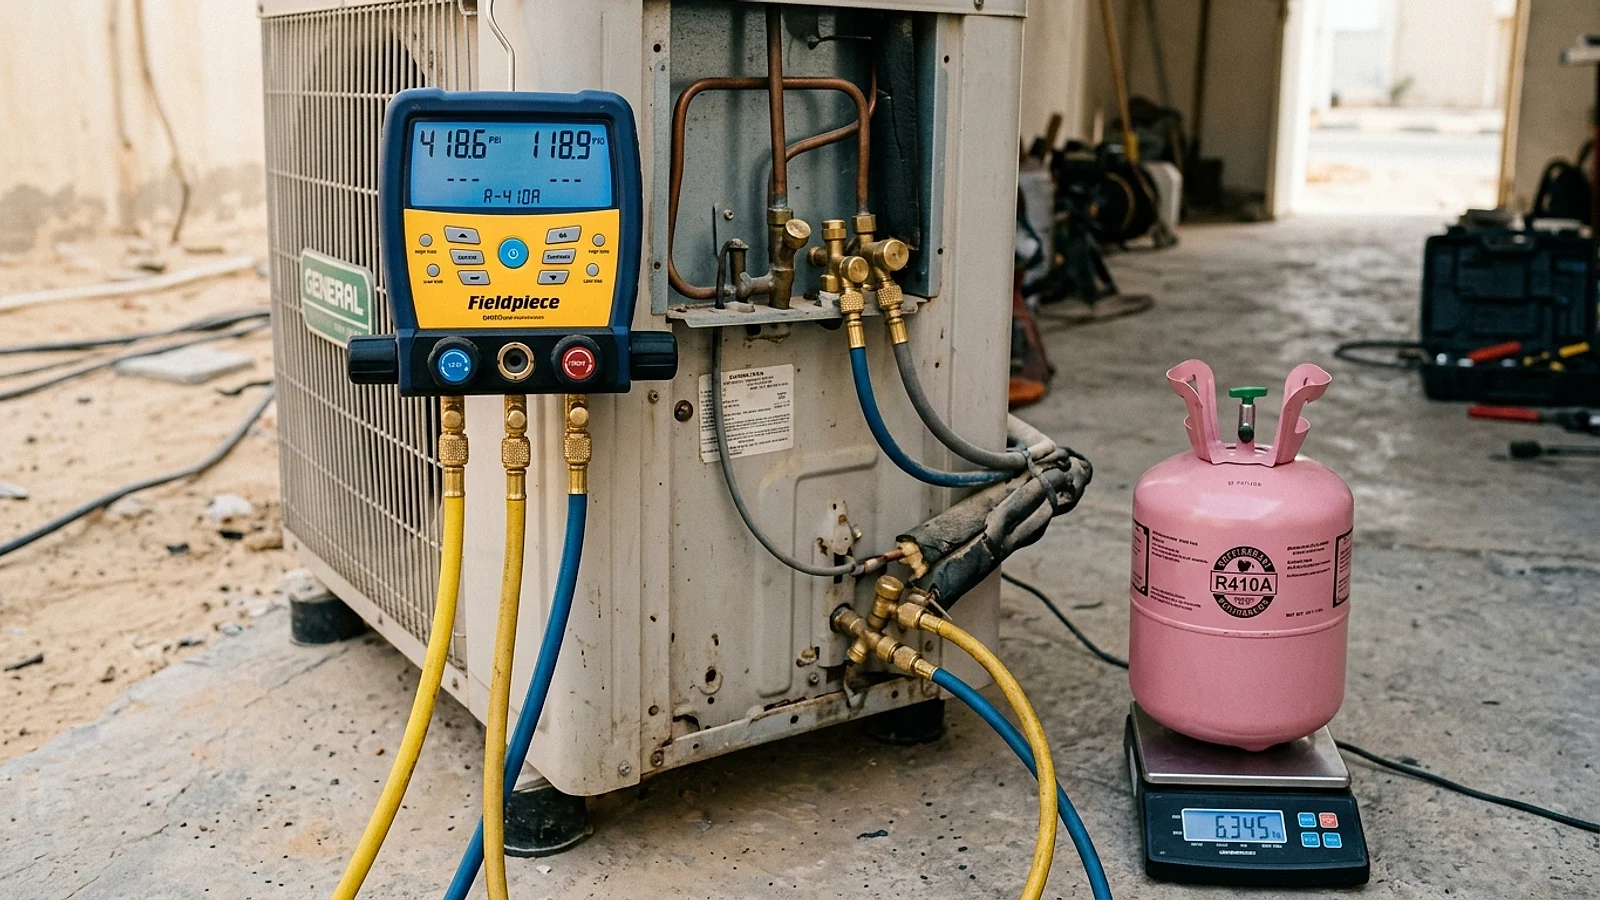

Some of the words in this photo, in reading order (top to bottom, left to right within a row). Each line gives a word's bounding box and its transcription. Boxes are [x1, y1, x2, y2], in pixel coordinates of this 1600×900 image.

[420, 129, 487, 159] 418.6
[533, 130, 591, 159] 118.9
[483, 189, 540, 205] R-410A
[305, 268, 363, 316] GENERAL
[468, 295, 560, 312] Fieldpiece
[1215, 575, 1272, 592] R410A
